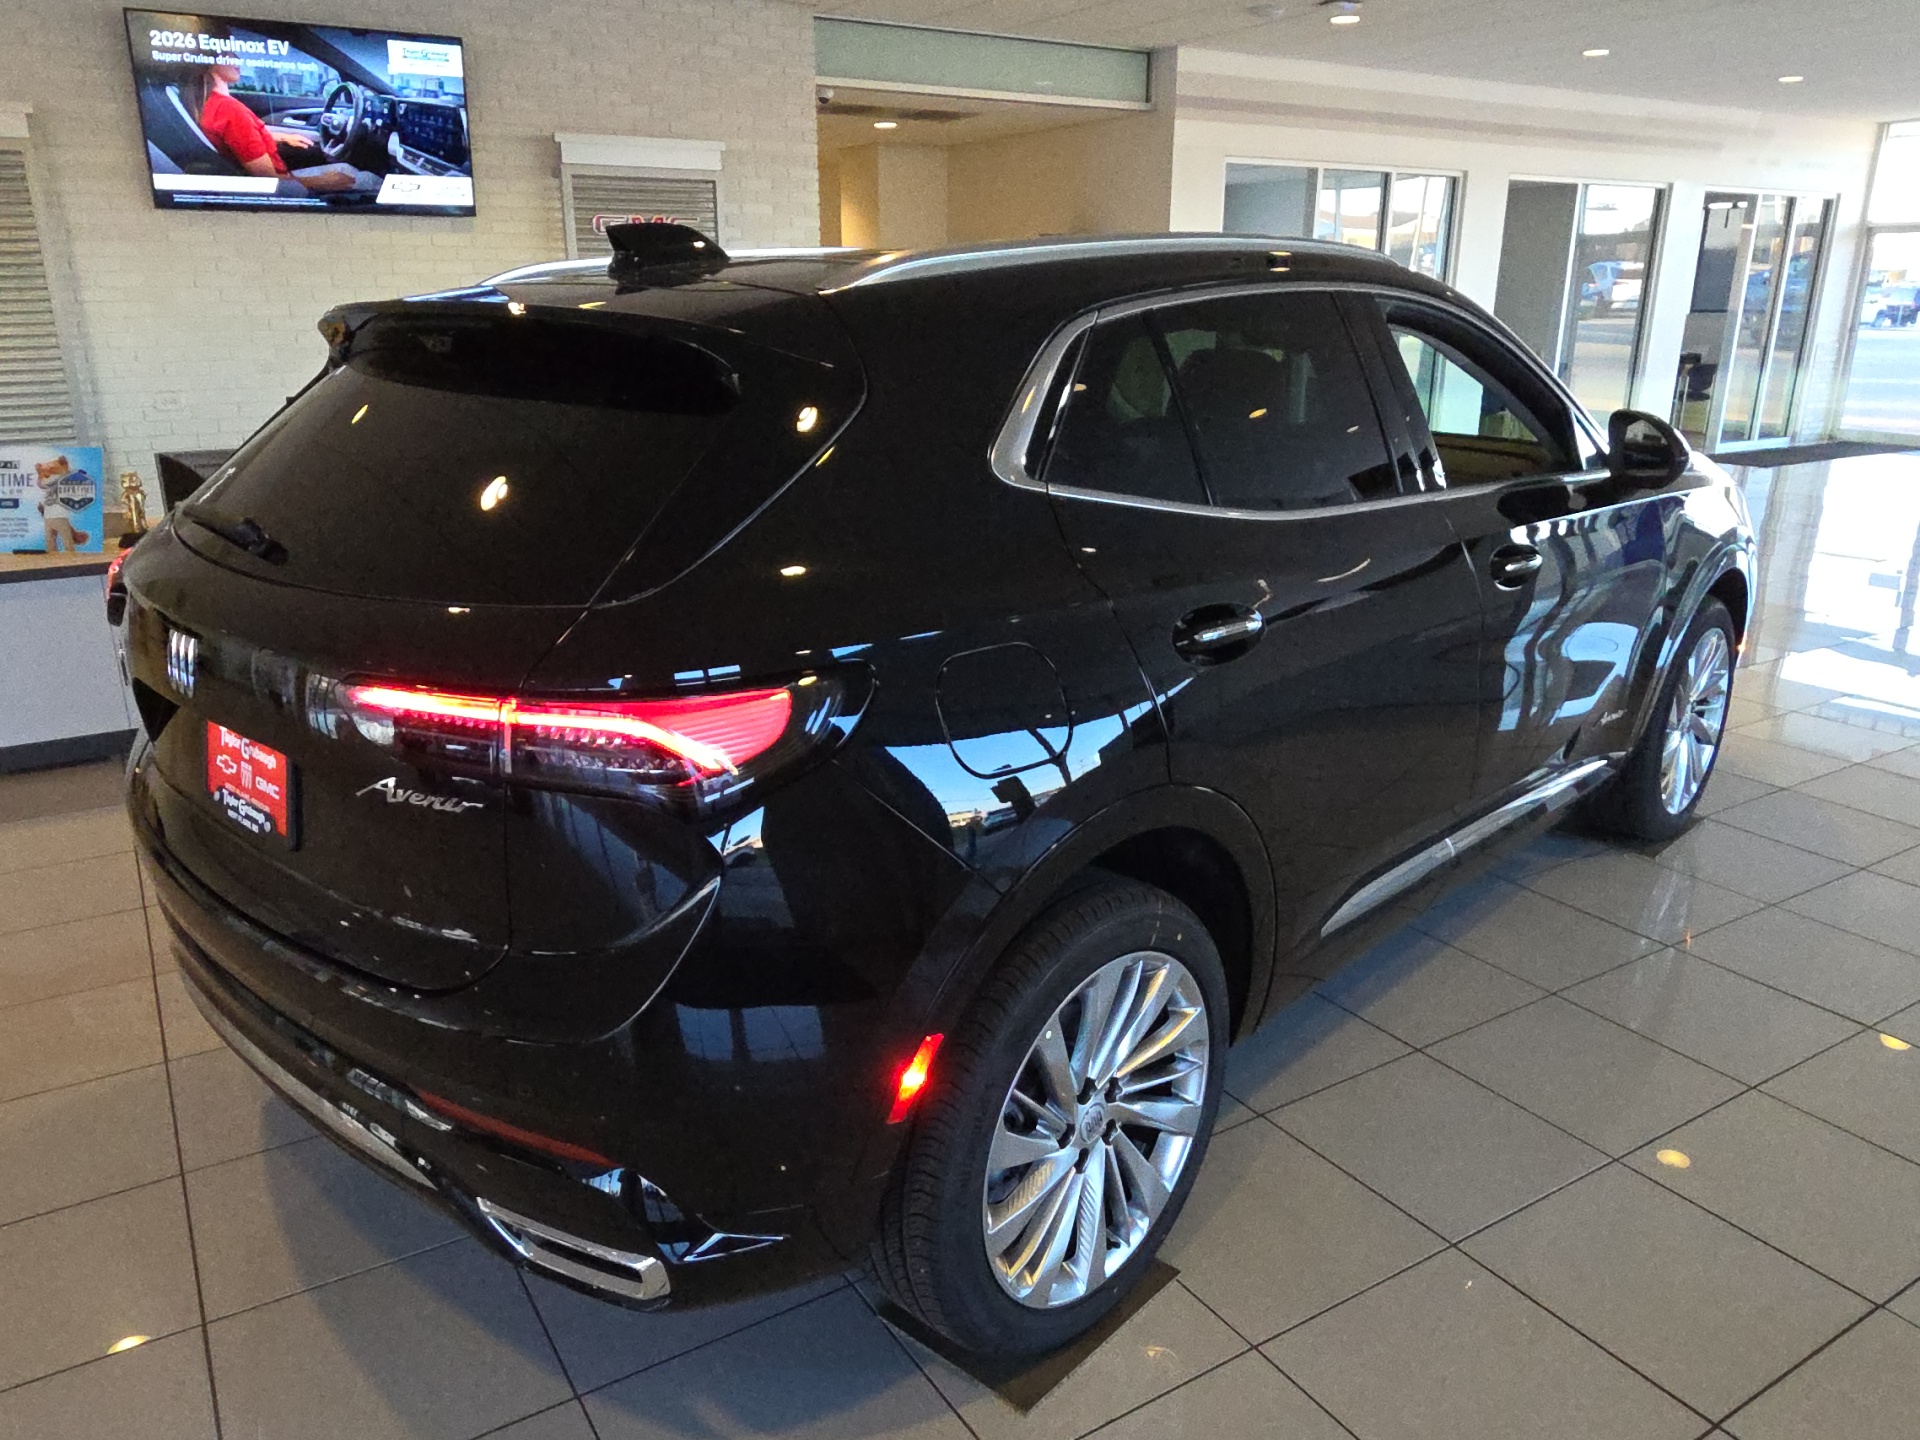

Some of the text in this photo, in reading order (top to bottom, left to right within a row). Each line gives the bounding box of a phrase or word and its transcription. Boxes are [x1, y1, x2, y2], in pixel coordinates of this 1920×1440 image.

[149, 29, 290, 56] 2026 Equinox EV
[151, 50, 319, 72] Super Cruise driver assistance tech
[255, 776, 280, 800] GMC
[355, 776, 484, 813] Avenir
